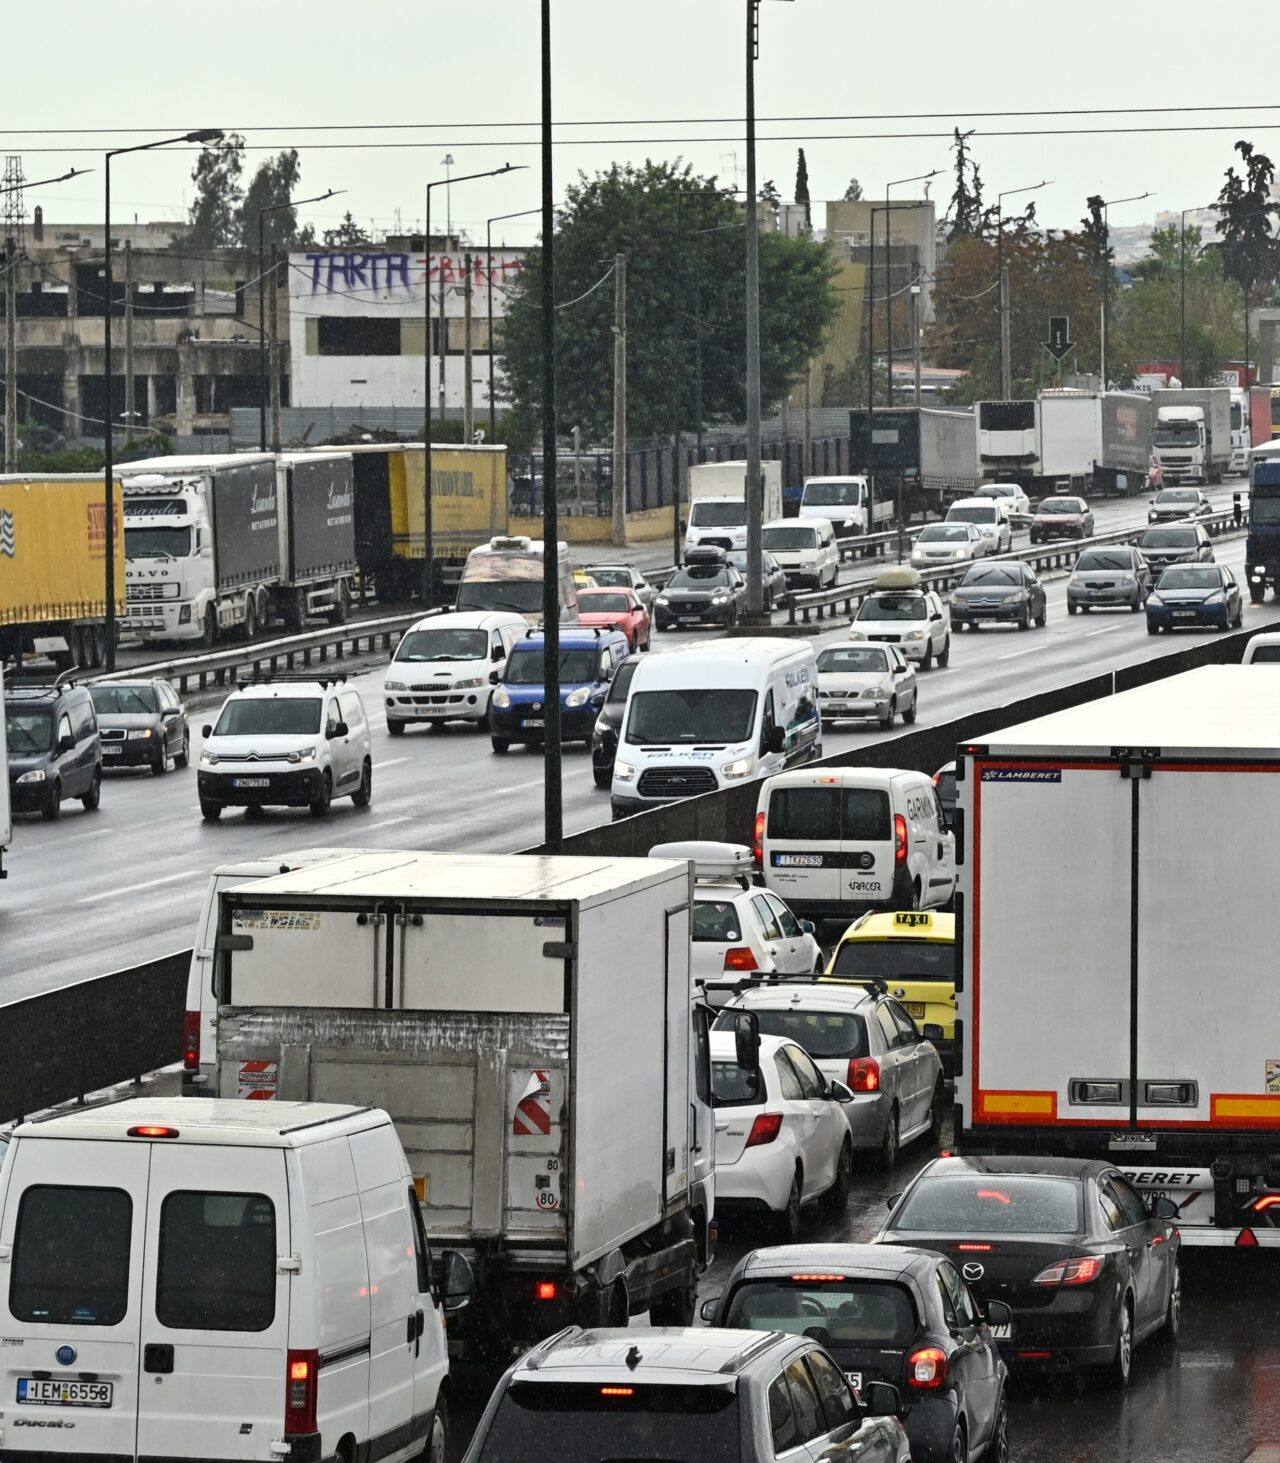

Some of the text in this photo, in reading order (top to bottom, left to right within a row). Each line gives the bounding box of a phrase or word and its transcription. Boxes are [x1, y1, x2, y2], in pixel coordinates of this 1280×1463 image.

[125, 570, 169, 578] OLVO
[998, 771, 1060, 780] LAMBERET
[907, 798, 935, 821] GARMIN
[898, 914, 927, 924] TAXI
[547, 1159, 559, 1171] 80
[1123, 1171, 1201, 1185] BERET
[540, 1193, 555, 1205] 80
[13, 1418, 76, 1429] Ducato
